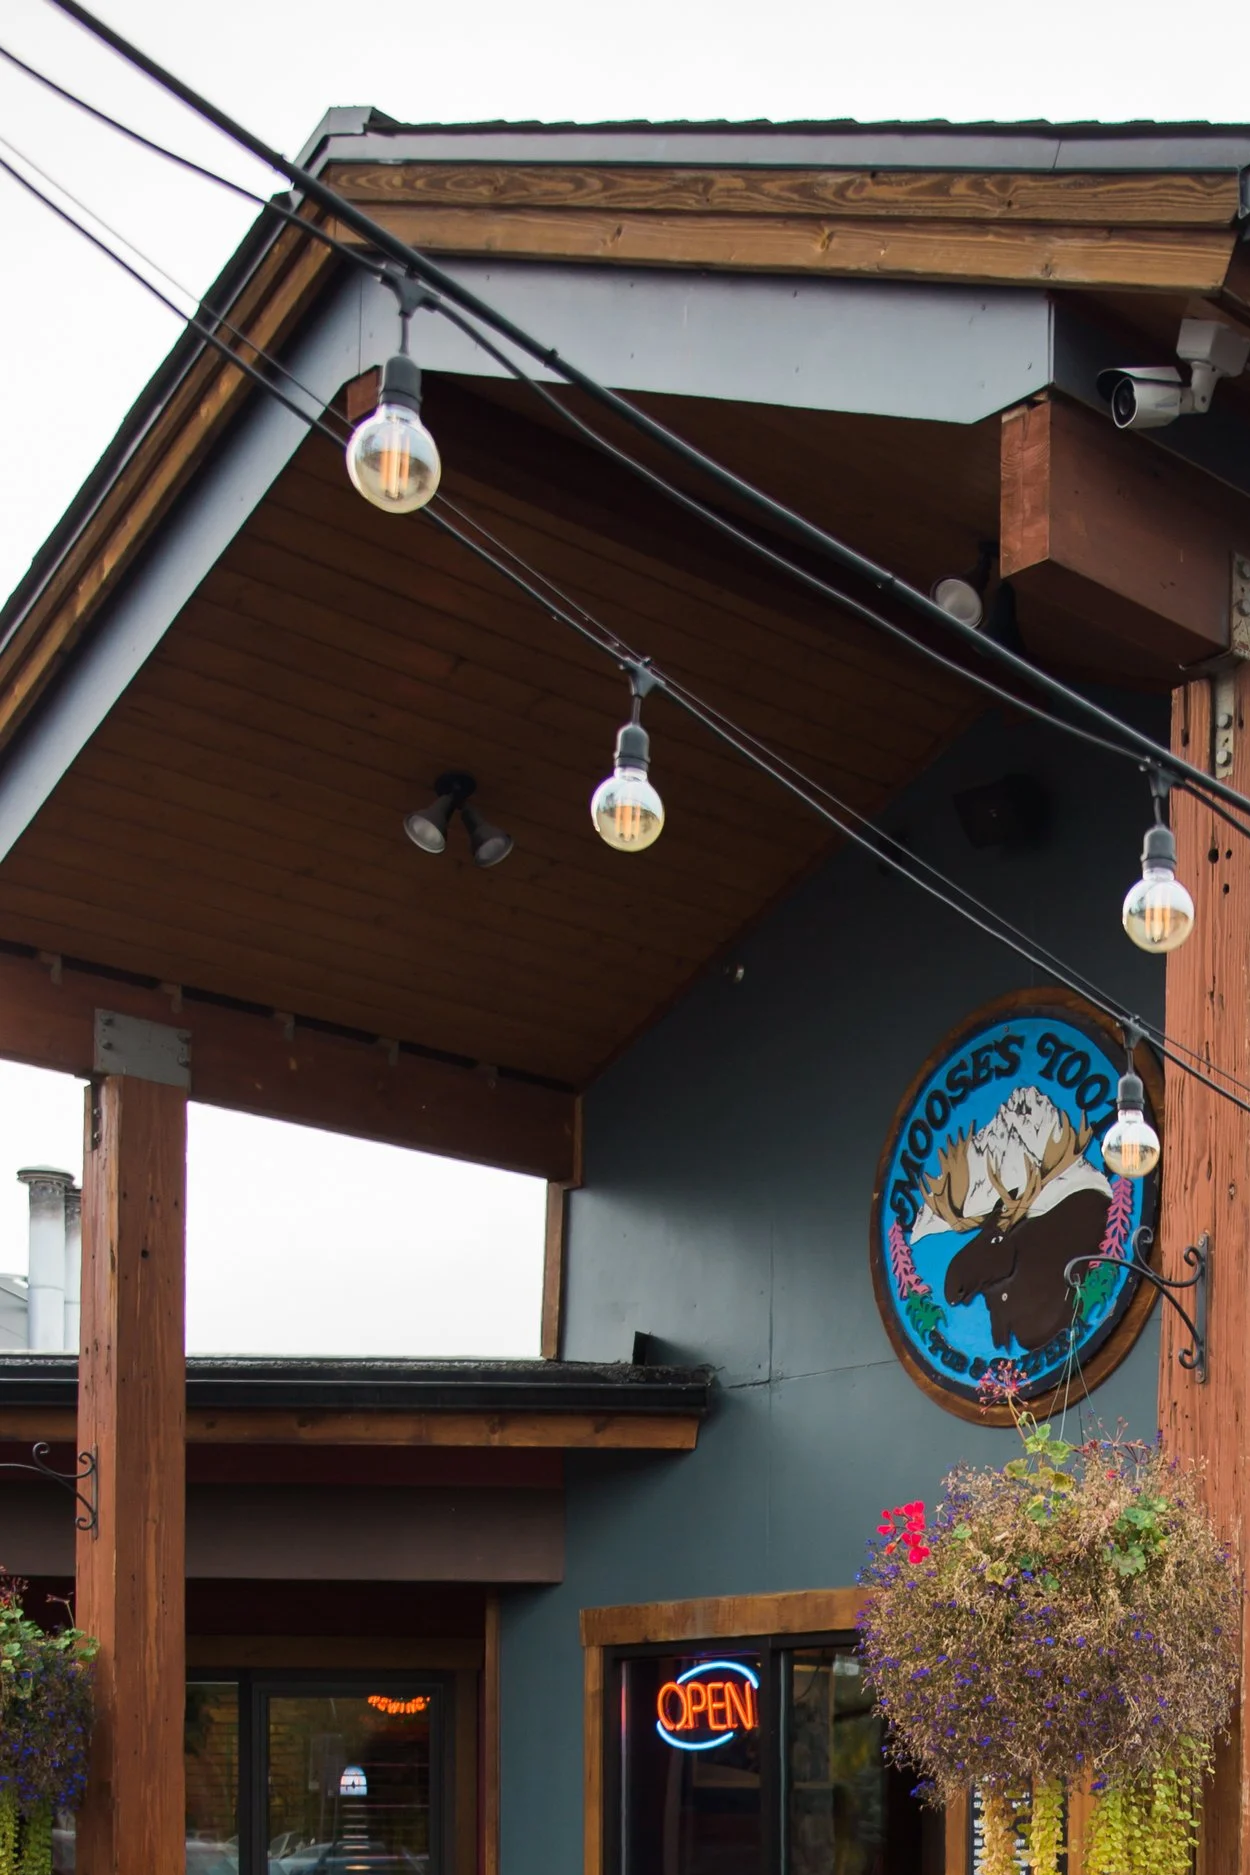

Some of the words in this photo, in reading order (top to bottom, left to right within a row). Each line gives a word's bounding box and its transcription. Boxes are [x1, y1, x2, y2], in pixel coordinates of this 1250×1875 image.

[1036, 1032, 1124, 1156] TOO
[928, 1329, 968, 1374] PUB
[657, 1681, 754, 1730] OPEN
